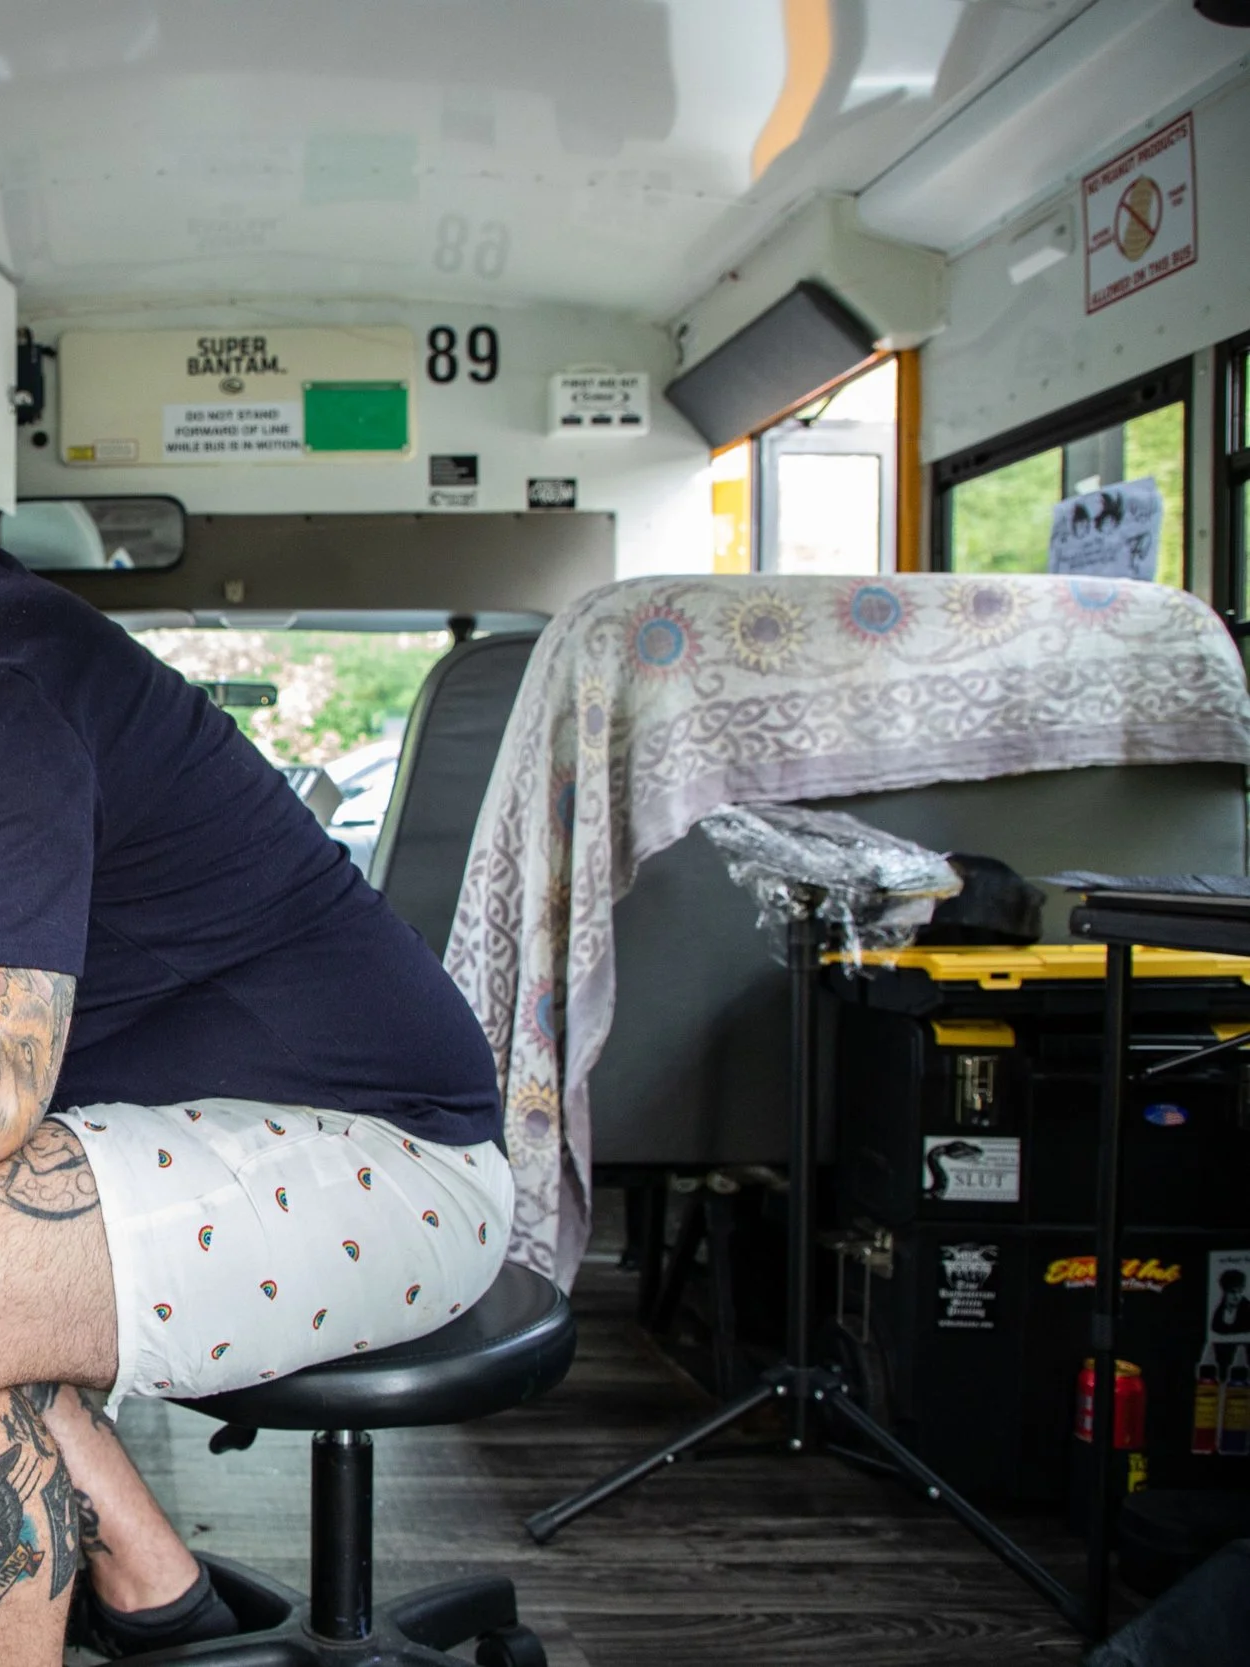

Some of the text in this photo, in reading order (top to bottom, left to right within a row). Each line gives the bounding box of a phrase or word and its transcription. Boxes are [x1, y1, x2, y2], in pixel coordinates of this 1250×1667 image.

[197, 336, 267, 357] SUPER
[427, 323, 500, 385] 89
[185, 409, 280, 422] DO NOT STAND
[175, 424, 290, 437] FORWARD OF LINE
[166, 443, 199, 453] WHILE
[204, 442, 225, 452] BUS
[231, 441, 239, 451] IS
[257, 440, 300, 451] MOTION
